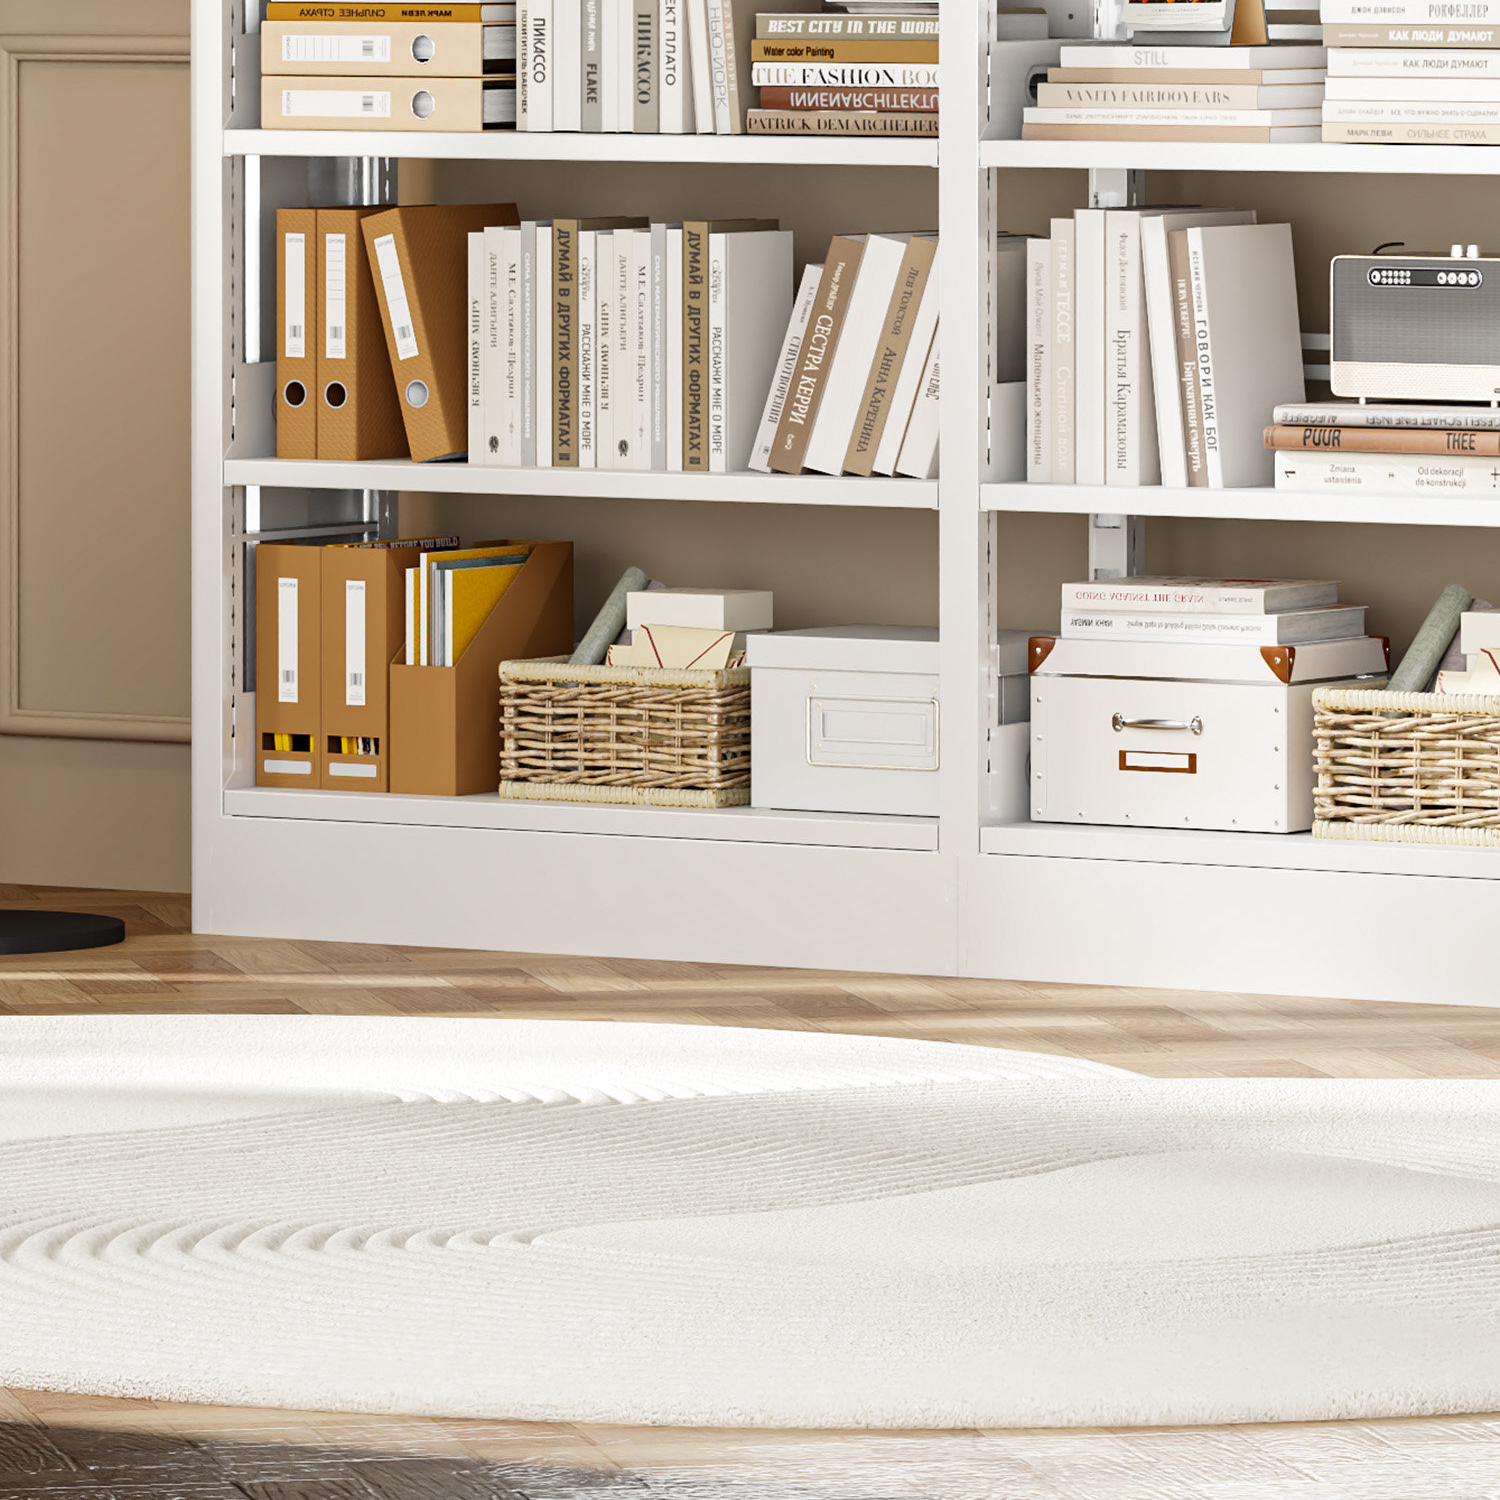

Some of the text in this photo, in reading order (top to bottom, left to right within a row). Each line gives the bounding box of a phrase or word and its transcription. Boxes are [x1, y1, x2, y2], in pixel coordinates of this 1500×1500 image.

[1428, 3, 1489, 18] РОКФЕЛЛЕР
[767, 20, 804, 33] BEST
[808, 20, 843, 34] CITY
[846, 20, 864, 34] IN
[867, 20, 897, 34] THE
[1388, 30, 1494, 43] КАК ЛЮДИ ДУМАЮТ
[533, 17, 546, 84] ПИКАССО
[637, 13, 652, 105] ПИКАССО
[664, 31, 677, 86] ПЛАТО
[710, 6, 728, 109] НЬЮ-ЙОРК
[763, 46, 835, 58] Water color Painting
[1133, 51, 1169, 66] STILL
[1402, 59, 1489, 70] КАК ЛЮДИ ДУМАЮТ
[586, 63, 598, 104] FLAKE
[756, 67, 796, 84] THE
[801, 68, 895, 85] FASHION
[748, 117, 938, 133] PATRICK DEMARCHELIER
[557, 228, 572, 448] ДУМАЙ В ДРУГИХ ФОРМАТАХ
[788, 315, 834, 426] СЕСТРА КЕРРИ
[1195, 319, 1218, 452] ГОВОРИ КАК БОГ
[1110, 329, 1131, 469] Братья Карамазовы
[1302, 428, 1476, 451] PUUR THEE
[1329, 463, 1355, 474] Zmiana
[1415, 476, 1426, 487] do
